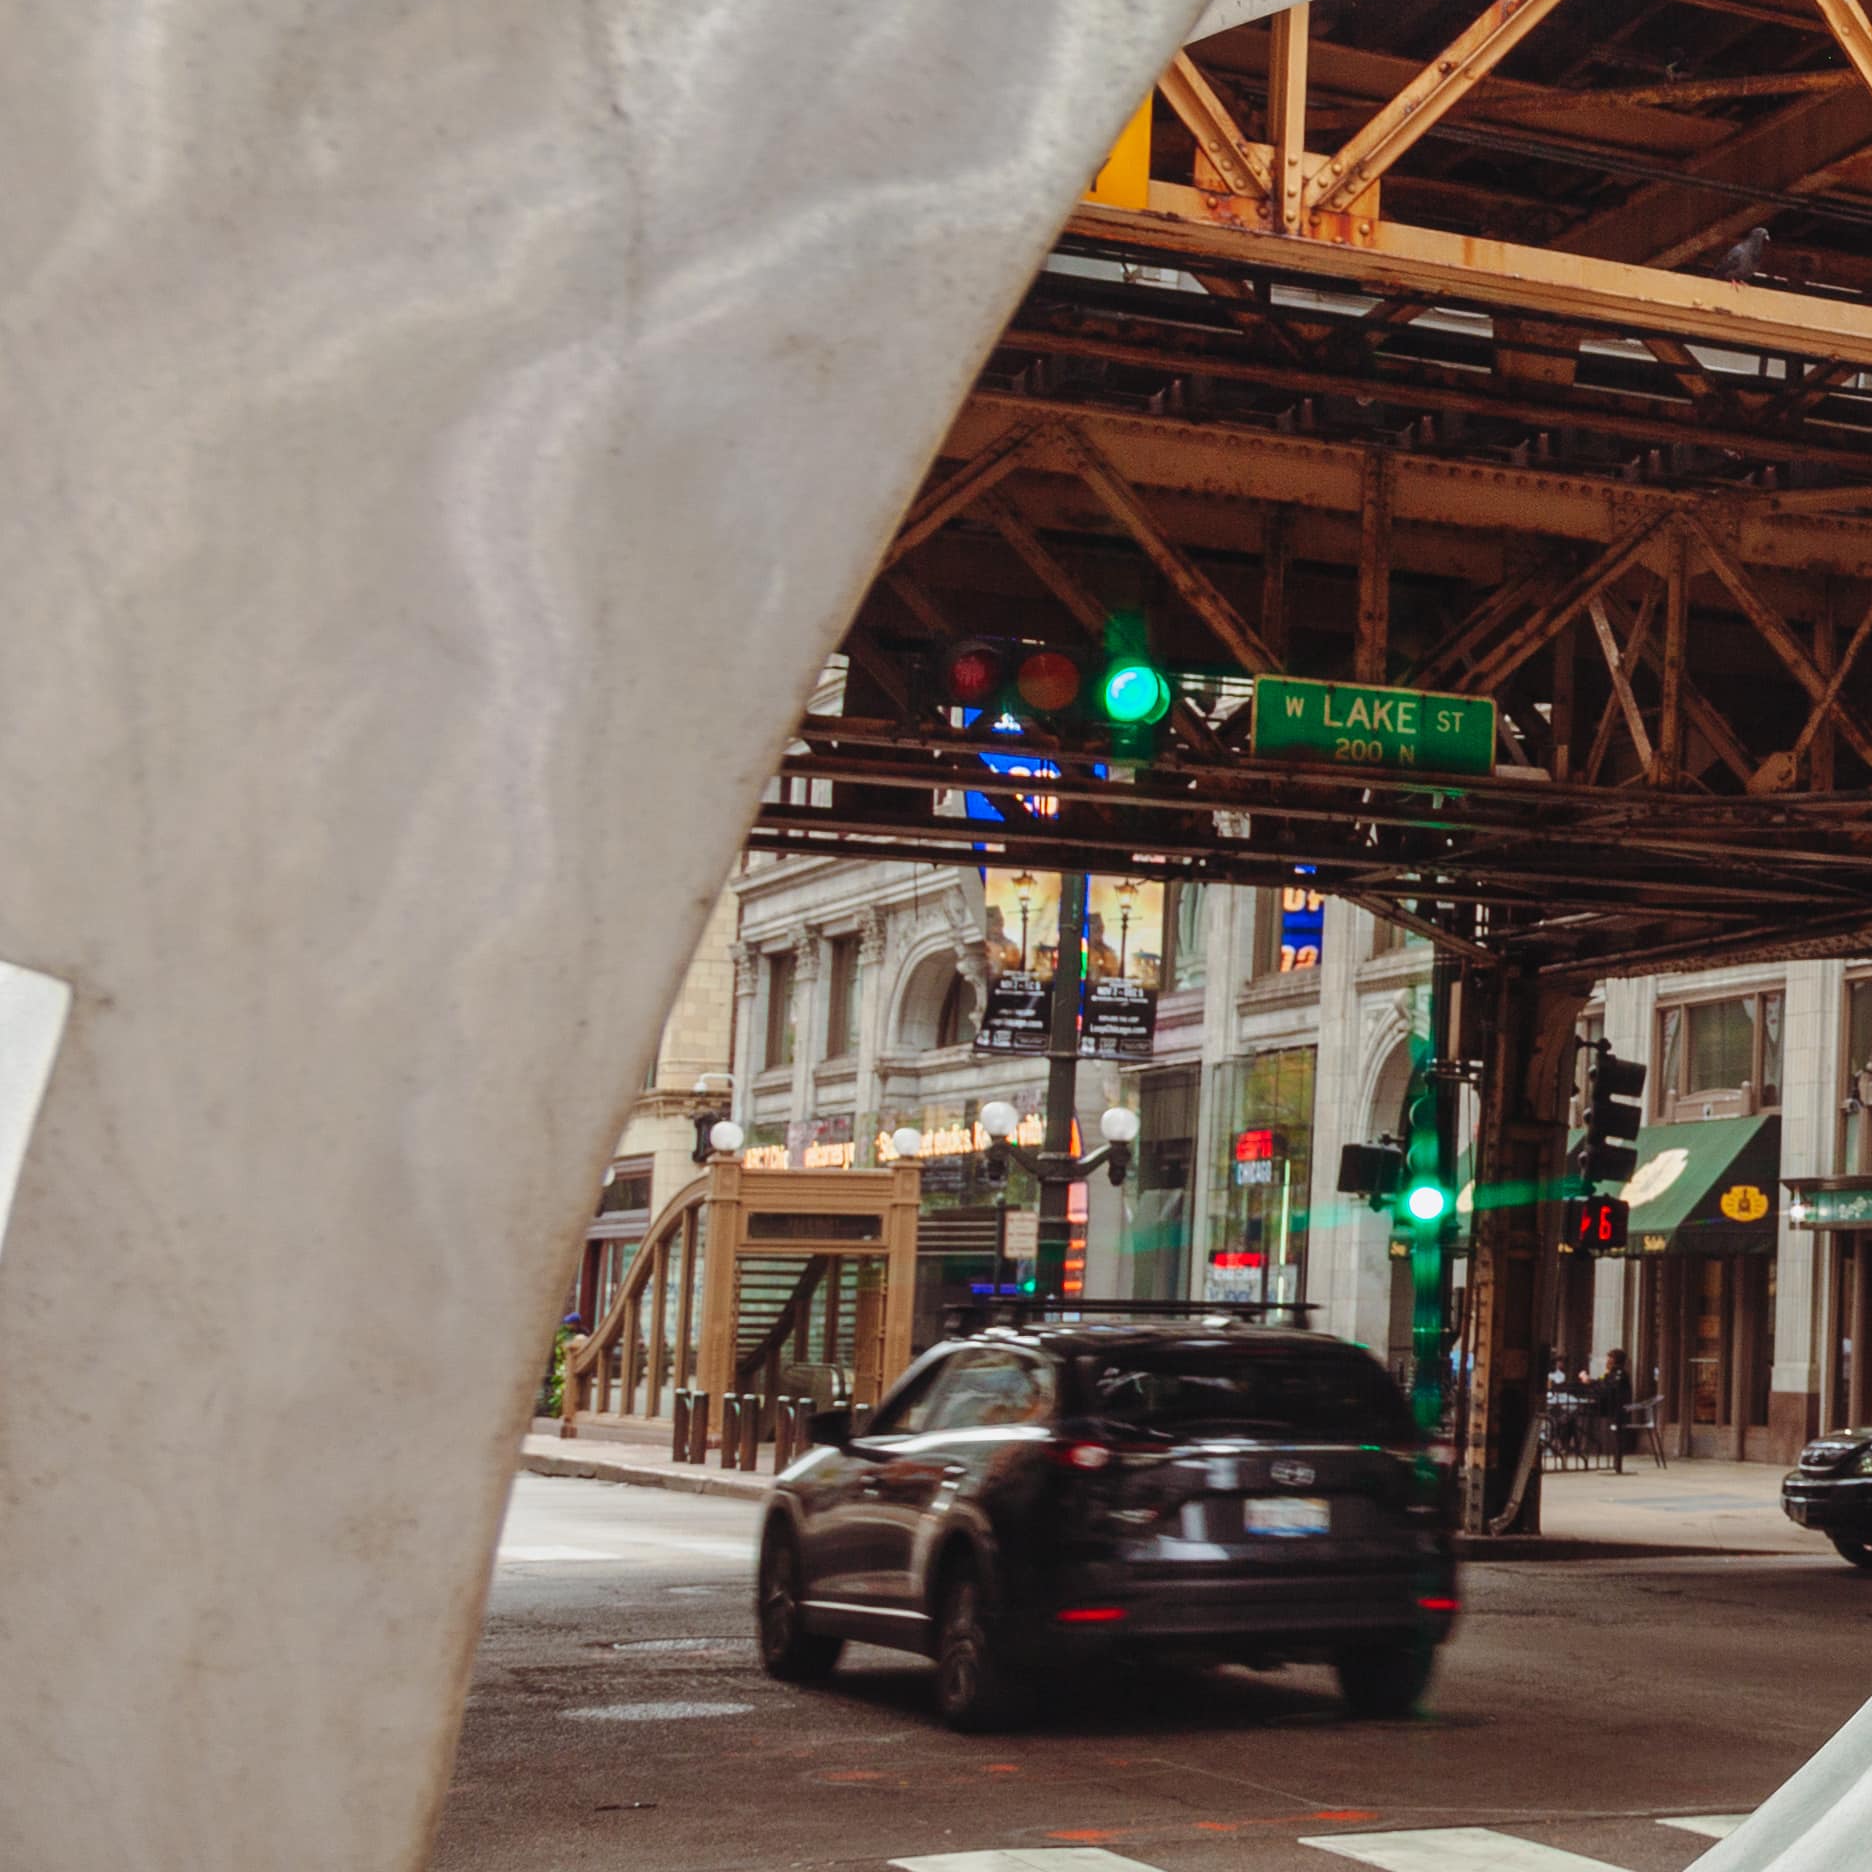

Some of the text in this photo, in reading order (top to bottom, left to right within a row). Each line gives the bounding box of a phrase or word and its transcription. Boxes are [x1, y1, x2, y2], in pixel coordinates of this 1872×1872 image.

[1285, 693, 1465, 735] W LAKE ST
[1334, 737, 1415, 764] 200 N
[1598, 1206, 1612, 1240] 6
